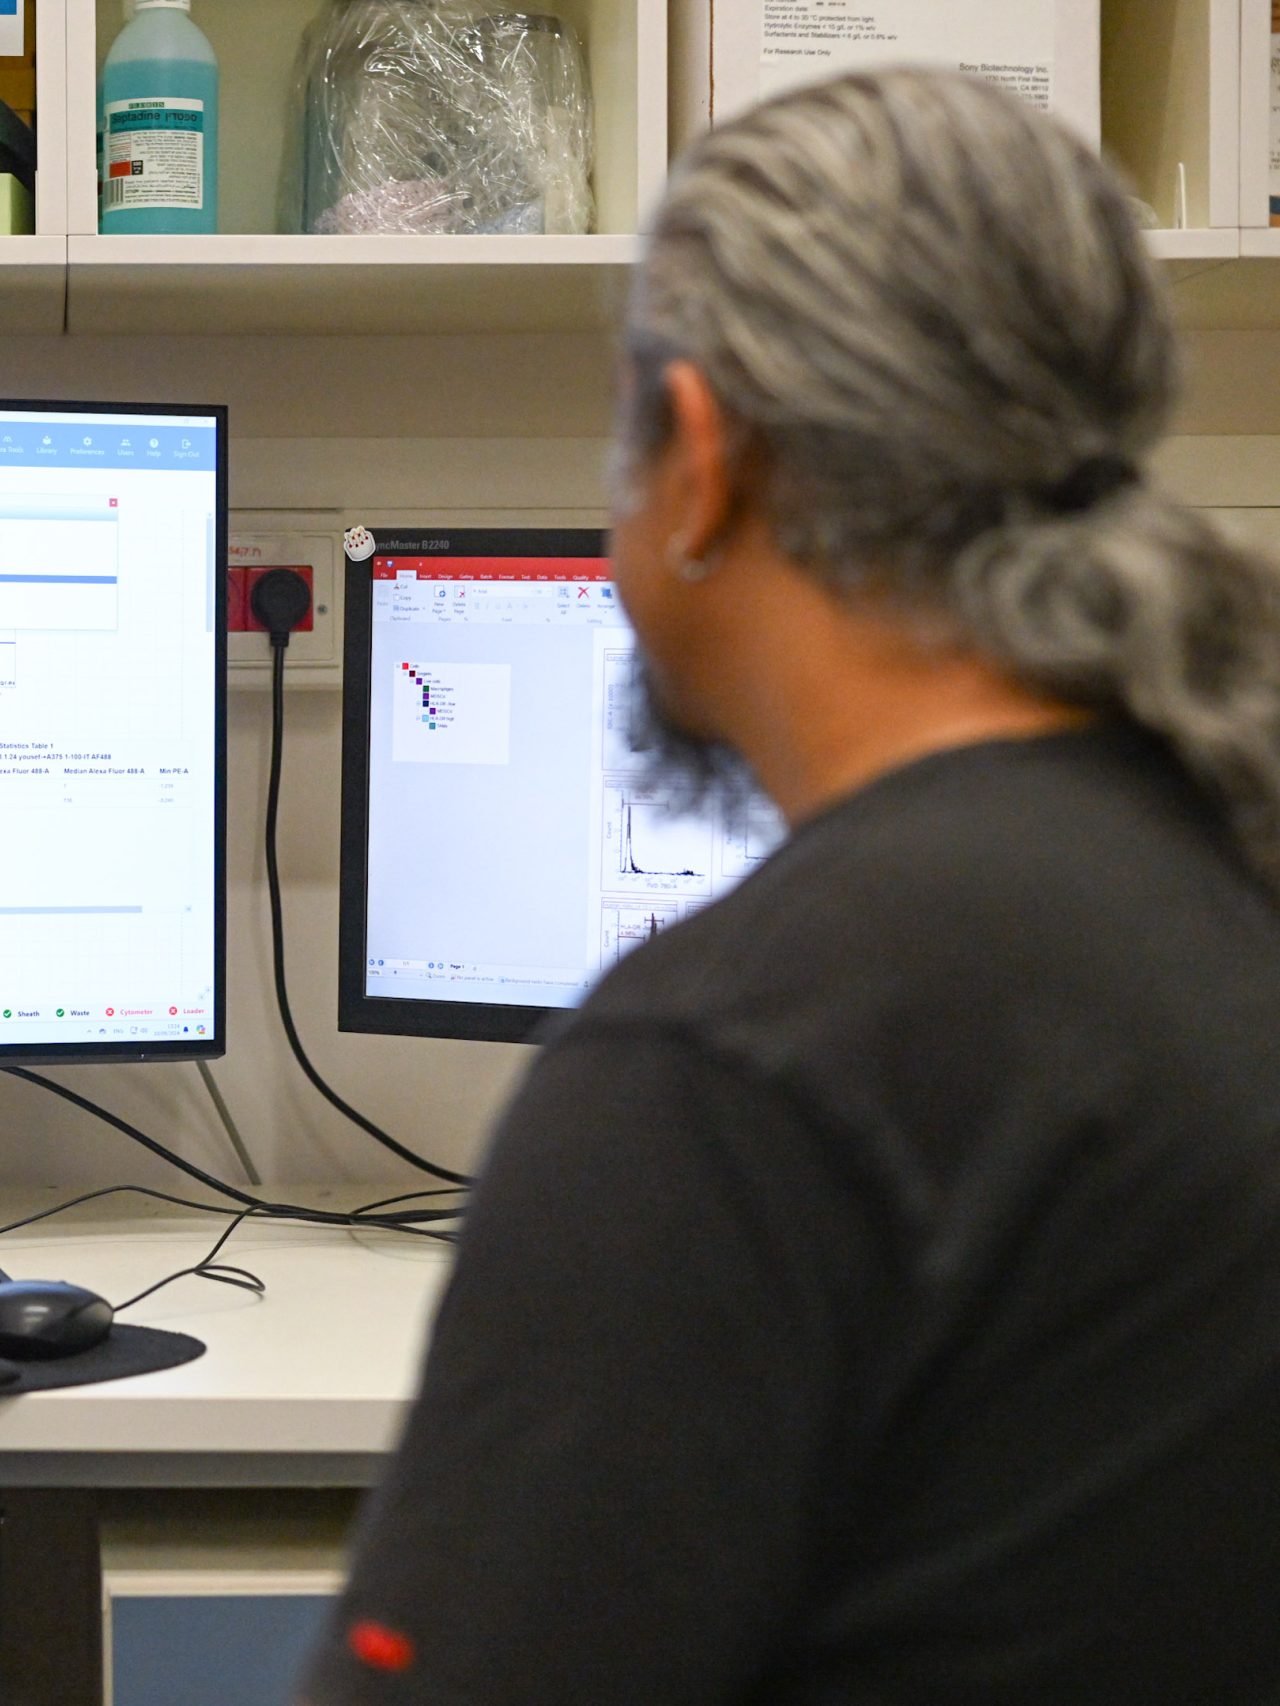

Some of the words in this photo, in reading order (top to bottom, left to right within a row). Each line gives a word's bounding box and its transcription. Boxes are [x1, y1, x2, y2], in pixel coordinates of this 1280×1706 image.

[960, 63, 978, 72] Sony
[980, 64, 1034, 74] Biotechnology
[70, 448, 104, 456] Preferences
[374, 540, 420, 551] yncMaster
[422, 540, 450, 550] B2240
